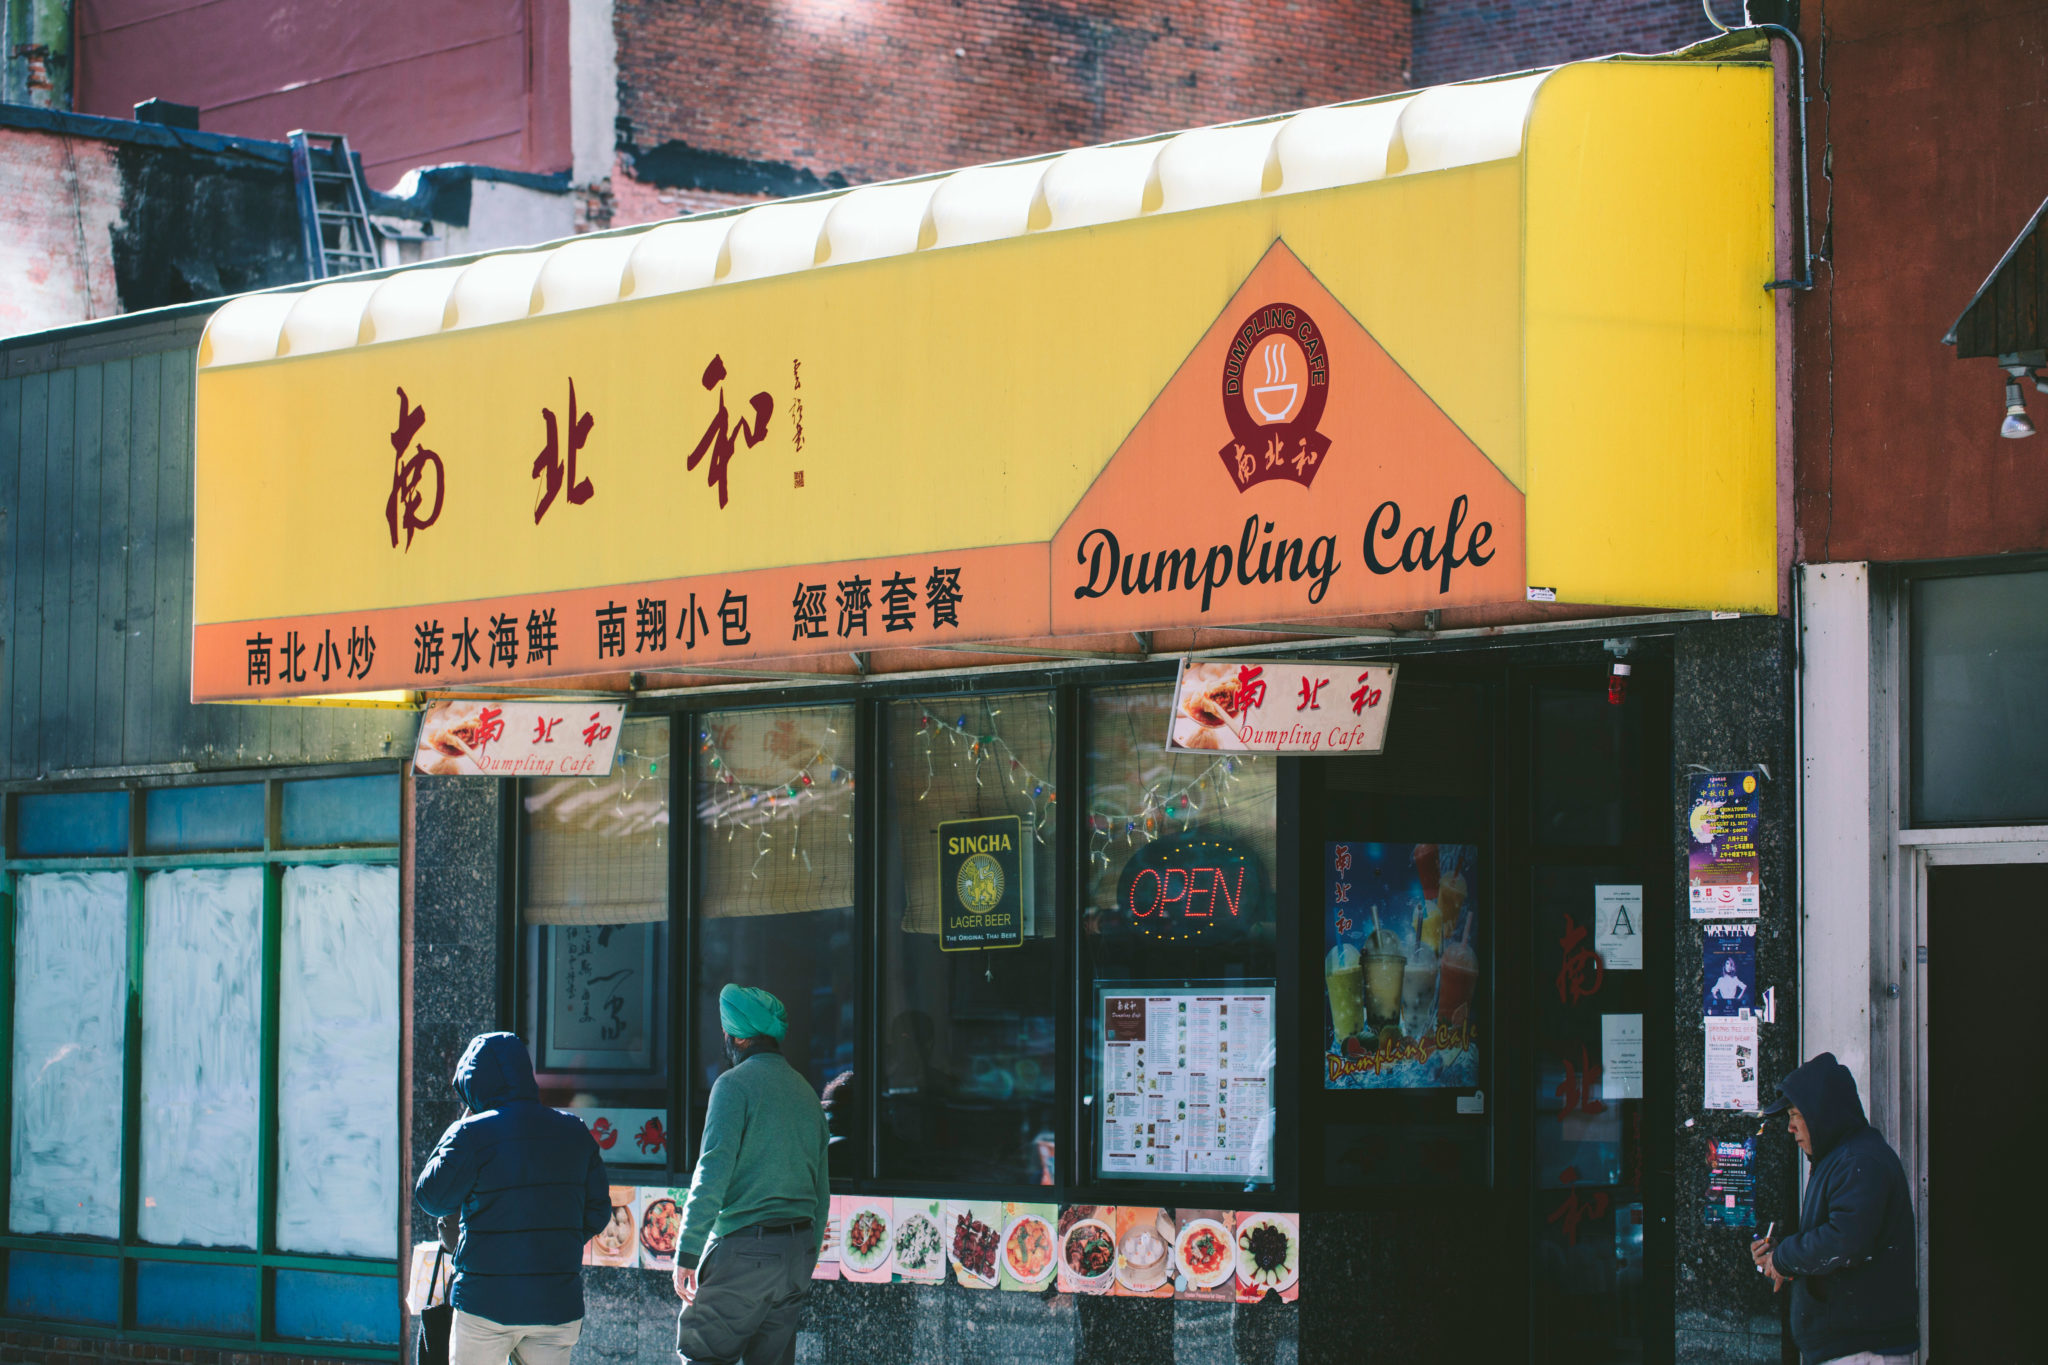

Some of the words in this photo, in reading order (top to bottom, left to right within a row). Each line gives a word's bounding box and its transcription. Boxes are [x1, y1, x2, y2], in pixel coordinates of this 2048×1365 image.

[1226, 308, 1296, 395] DUMPLING
[1297, 321, 1325, 387] CAFE
[1074, 513, 1342, 613] Dumpling
[1362, 494, 1496, 595] Cafe
[246, 625, 377, 686] 南北小炒
[414, 607, 559, 675] 游水海鮮
[595, 588, 752, 660] 南翔小包
[792, 566, 964, 642] 經濟套餐
[1233, 664, 1382, 727] 南北和
[474, 706, 612, 756] 南北和
[1239, 723, 1322, 751] Dumpling
[1328, 724, 1366, 752] Cafe
[478, 753, 555, 776] Dumpling
[559, 752, 596, 776] Cafe
[948, 833, 1012, 856] SINGHA
[1129, 867, 1245, 917] OPEN
[950, 915, 983, 929] LAGER
[985, 913, 1011, 927] BEER
[1610, 904, 1636, 936] A
